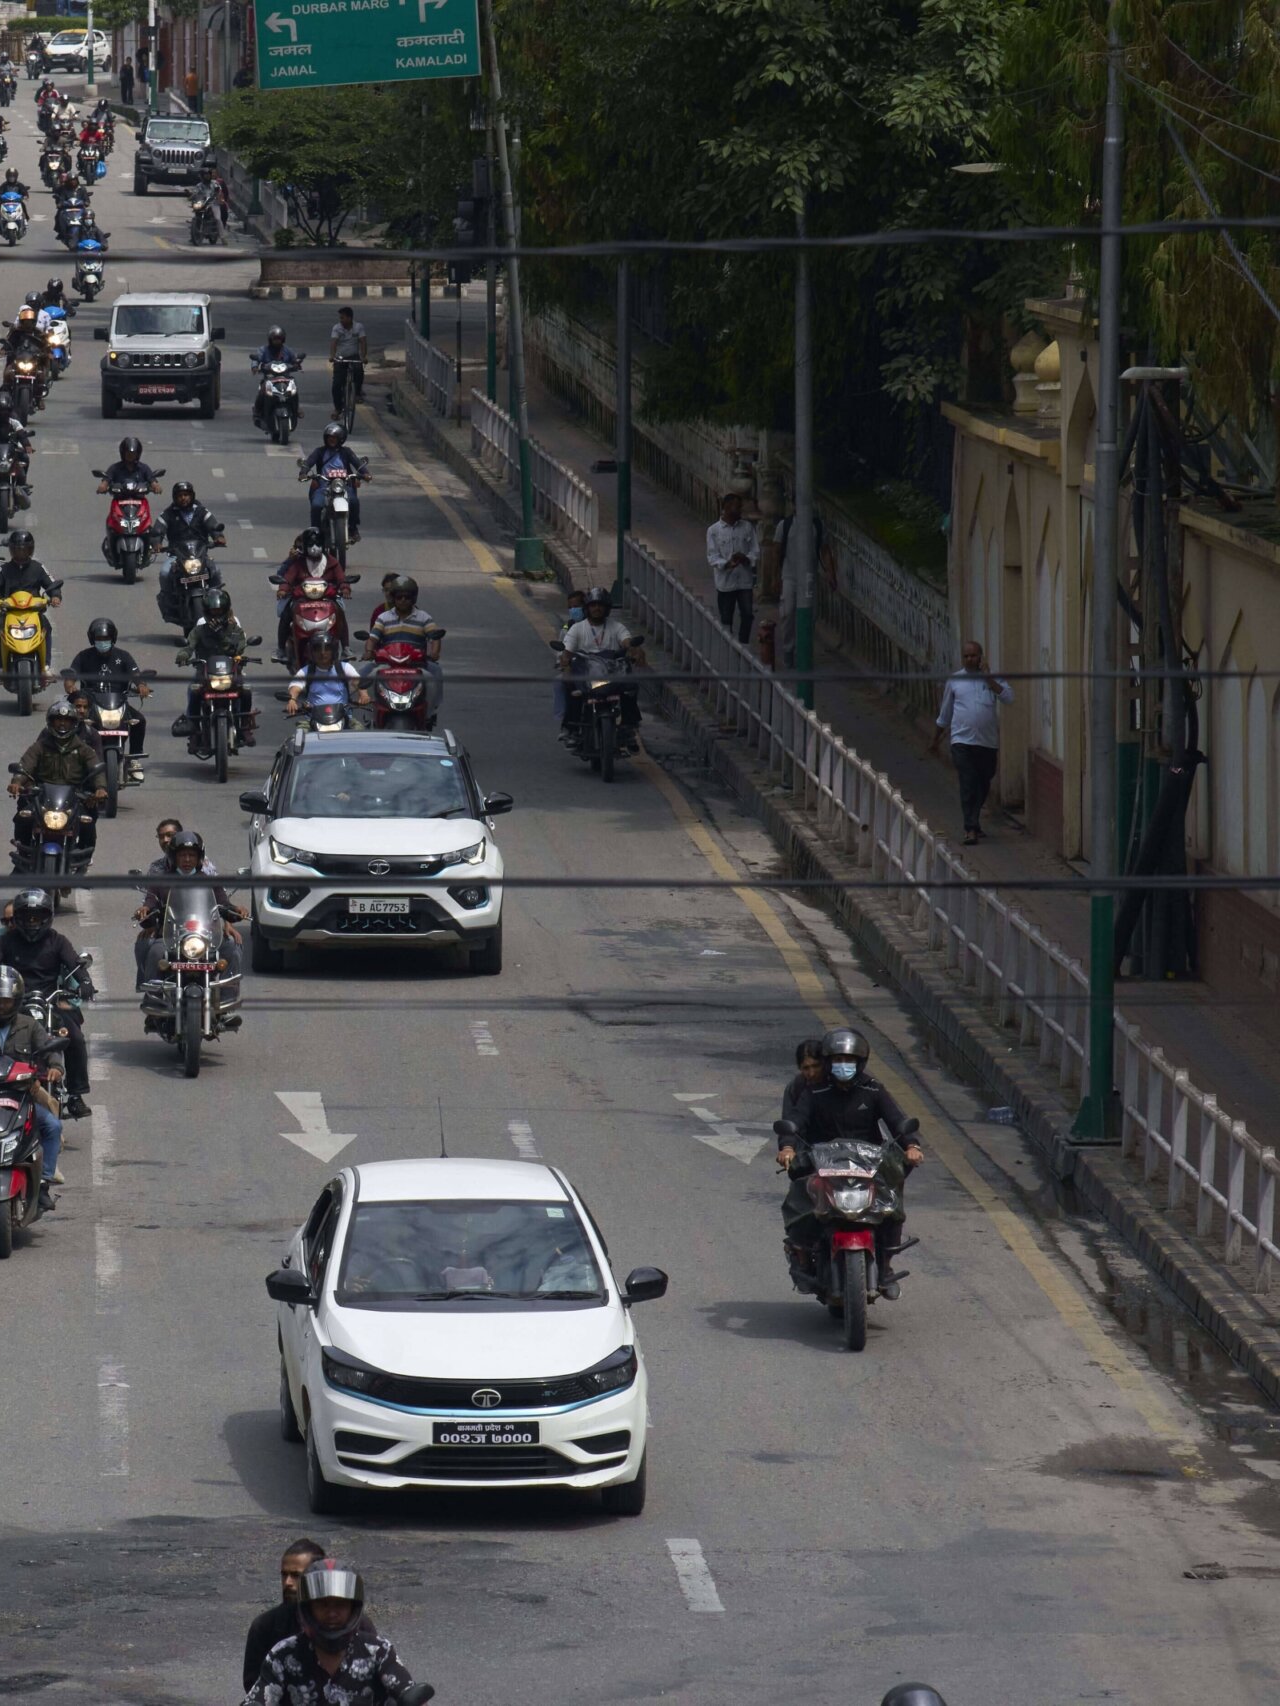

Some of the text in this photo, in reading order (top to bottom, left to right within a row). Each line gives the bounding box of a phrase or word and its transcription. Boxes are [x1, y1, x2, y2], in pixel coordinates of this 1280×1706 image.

[292, 0, 389, 15] DURBAR MARG
[396, 28, 465, 47] कमलादी
[268, 44, 312, 57] जमल
[395, 54, 467, 68] KAMALADI
[270, 64, 317, 78] JAMAL
[359, 903, 366, 912] B
